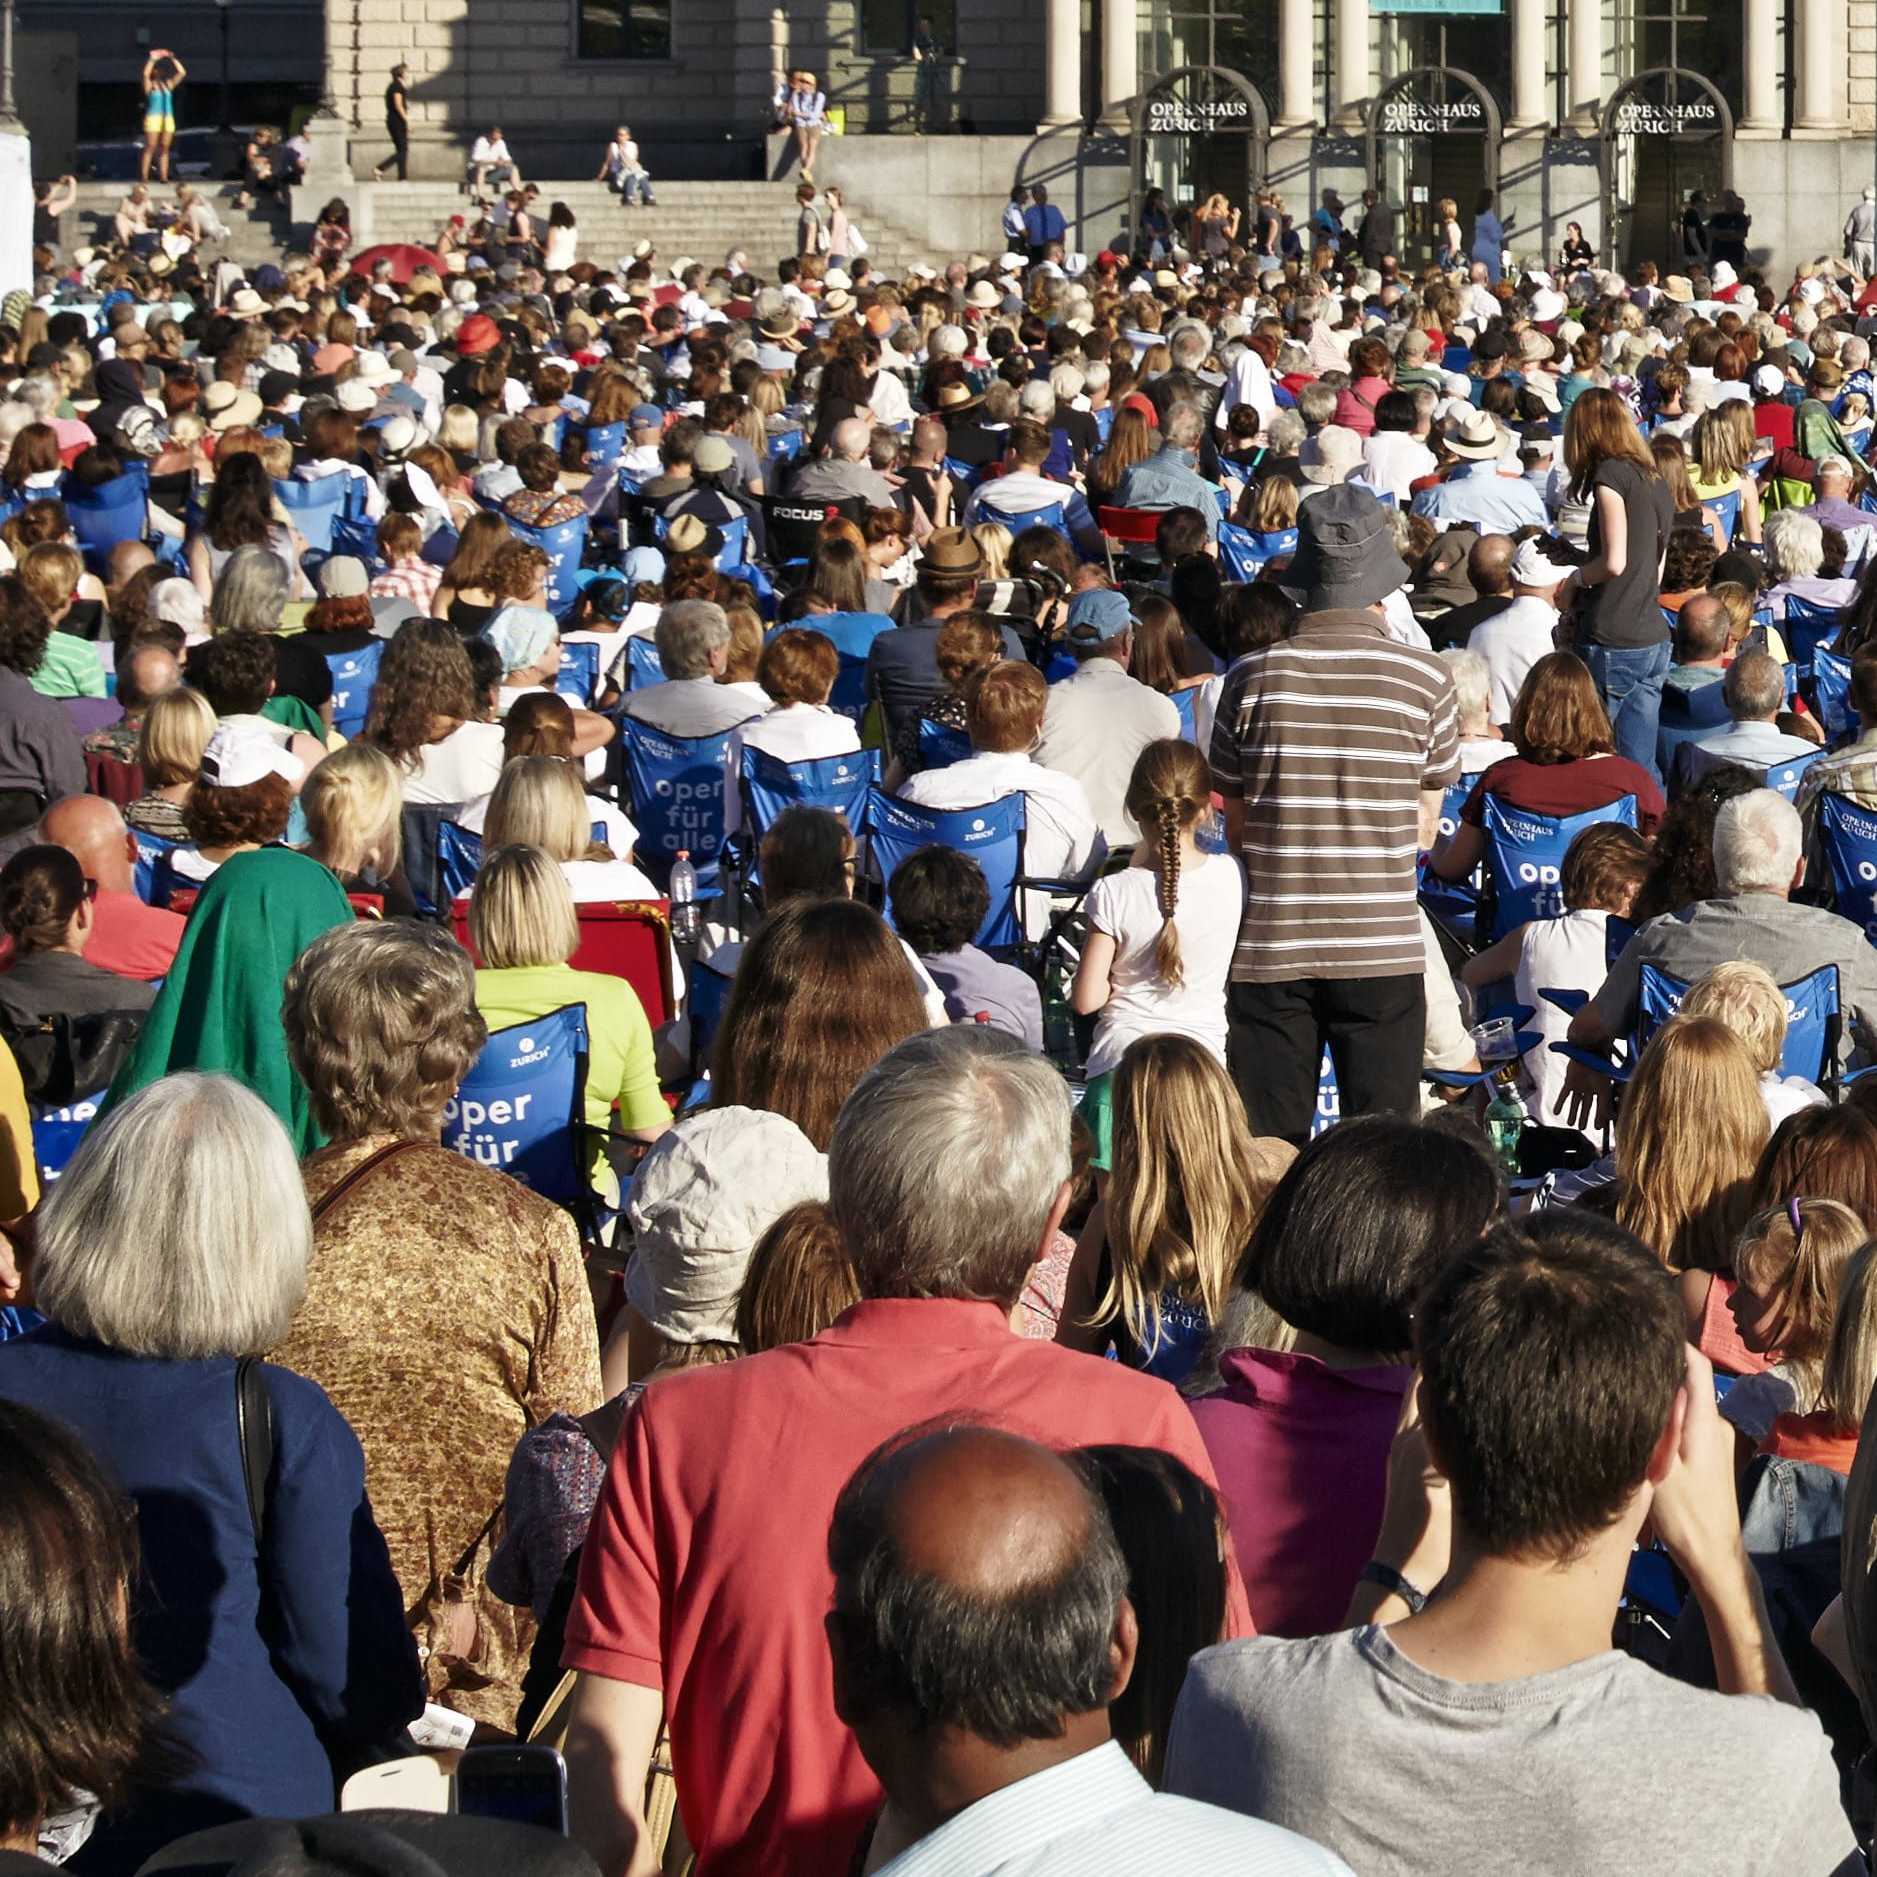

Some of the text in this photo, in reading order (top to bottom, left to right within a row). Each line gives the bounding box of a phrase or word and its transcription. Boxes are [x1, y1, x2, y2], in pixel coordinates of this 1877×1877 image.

[1150, 102, 1248, 117] OPERNHAUS
[1385, 103, 1481, 118] OPERNHAUS
[1618, 104, 1715, 119] OPERNHAUS
[773, 507, 824, 521] FOCUS
[655, 779, 721, 808] oper
[666, 803, 715, 829] für
[662, 828, 717, 853] alle
[965, 826, 996, 842] ZURICH
[1519, 861, 1560, 892] op
[510, 1048, 549, 1069] ZURICH
[455, 1132, 520, 1166] für
